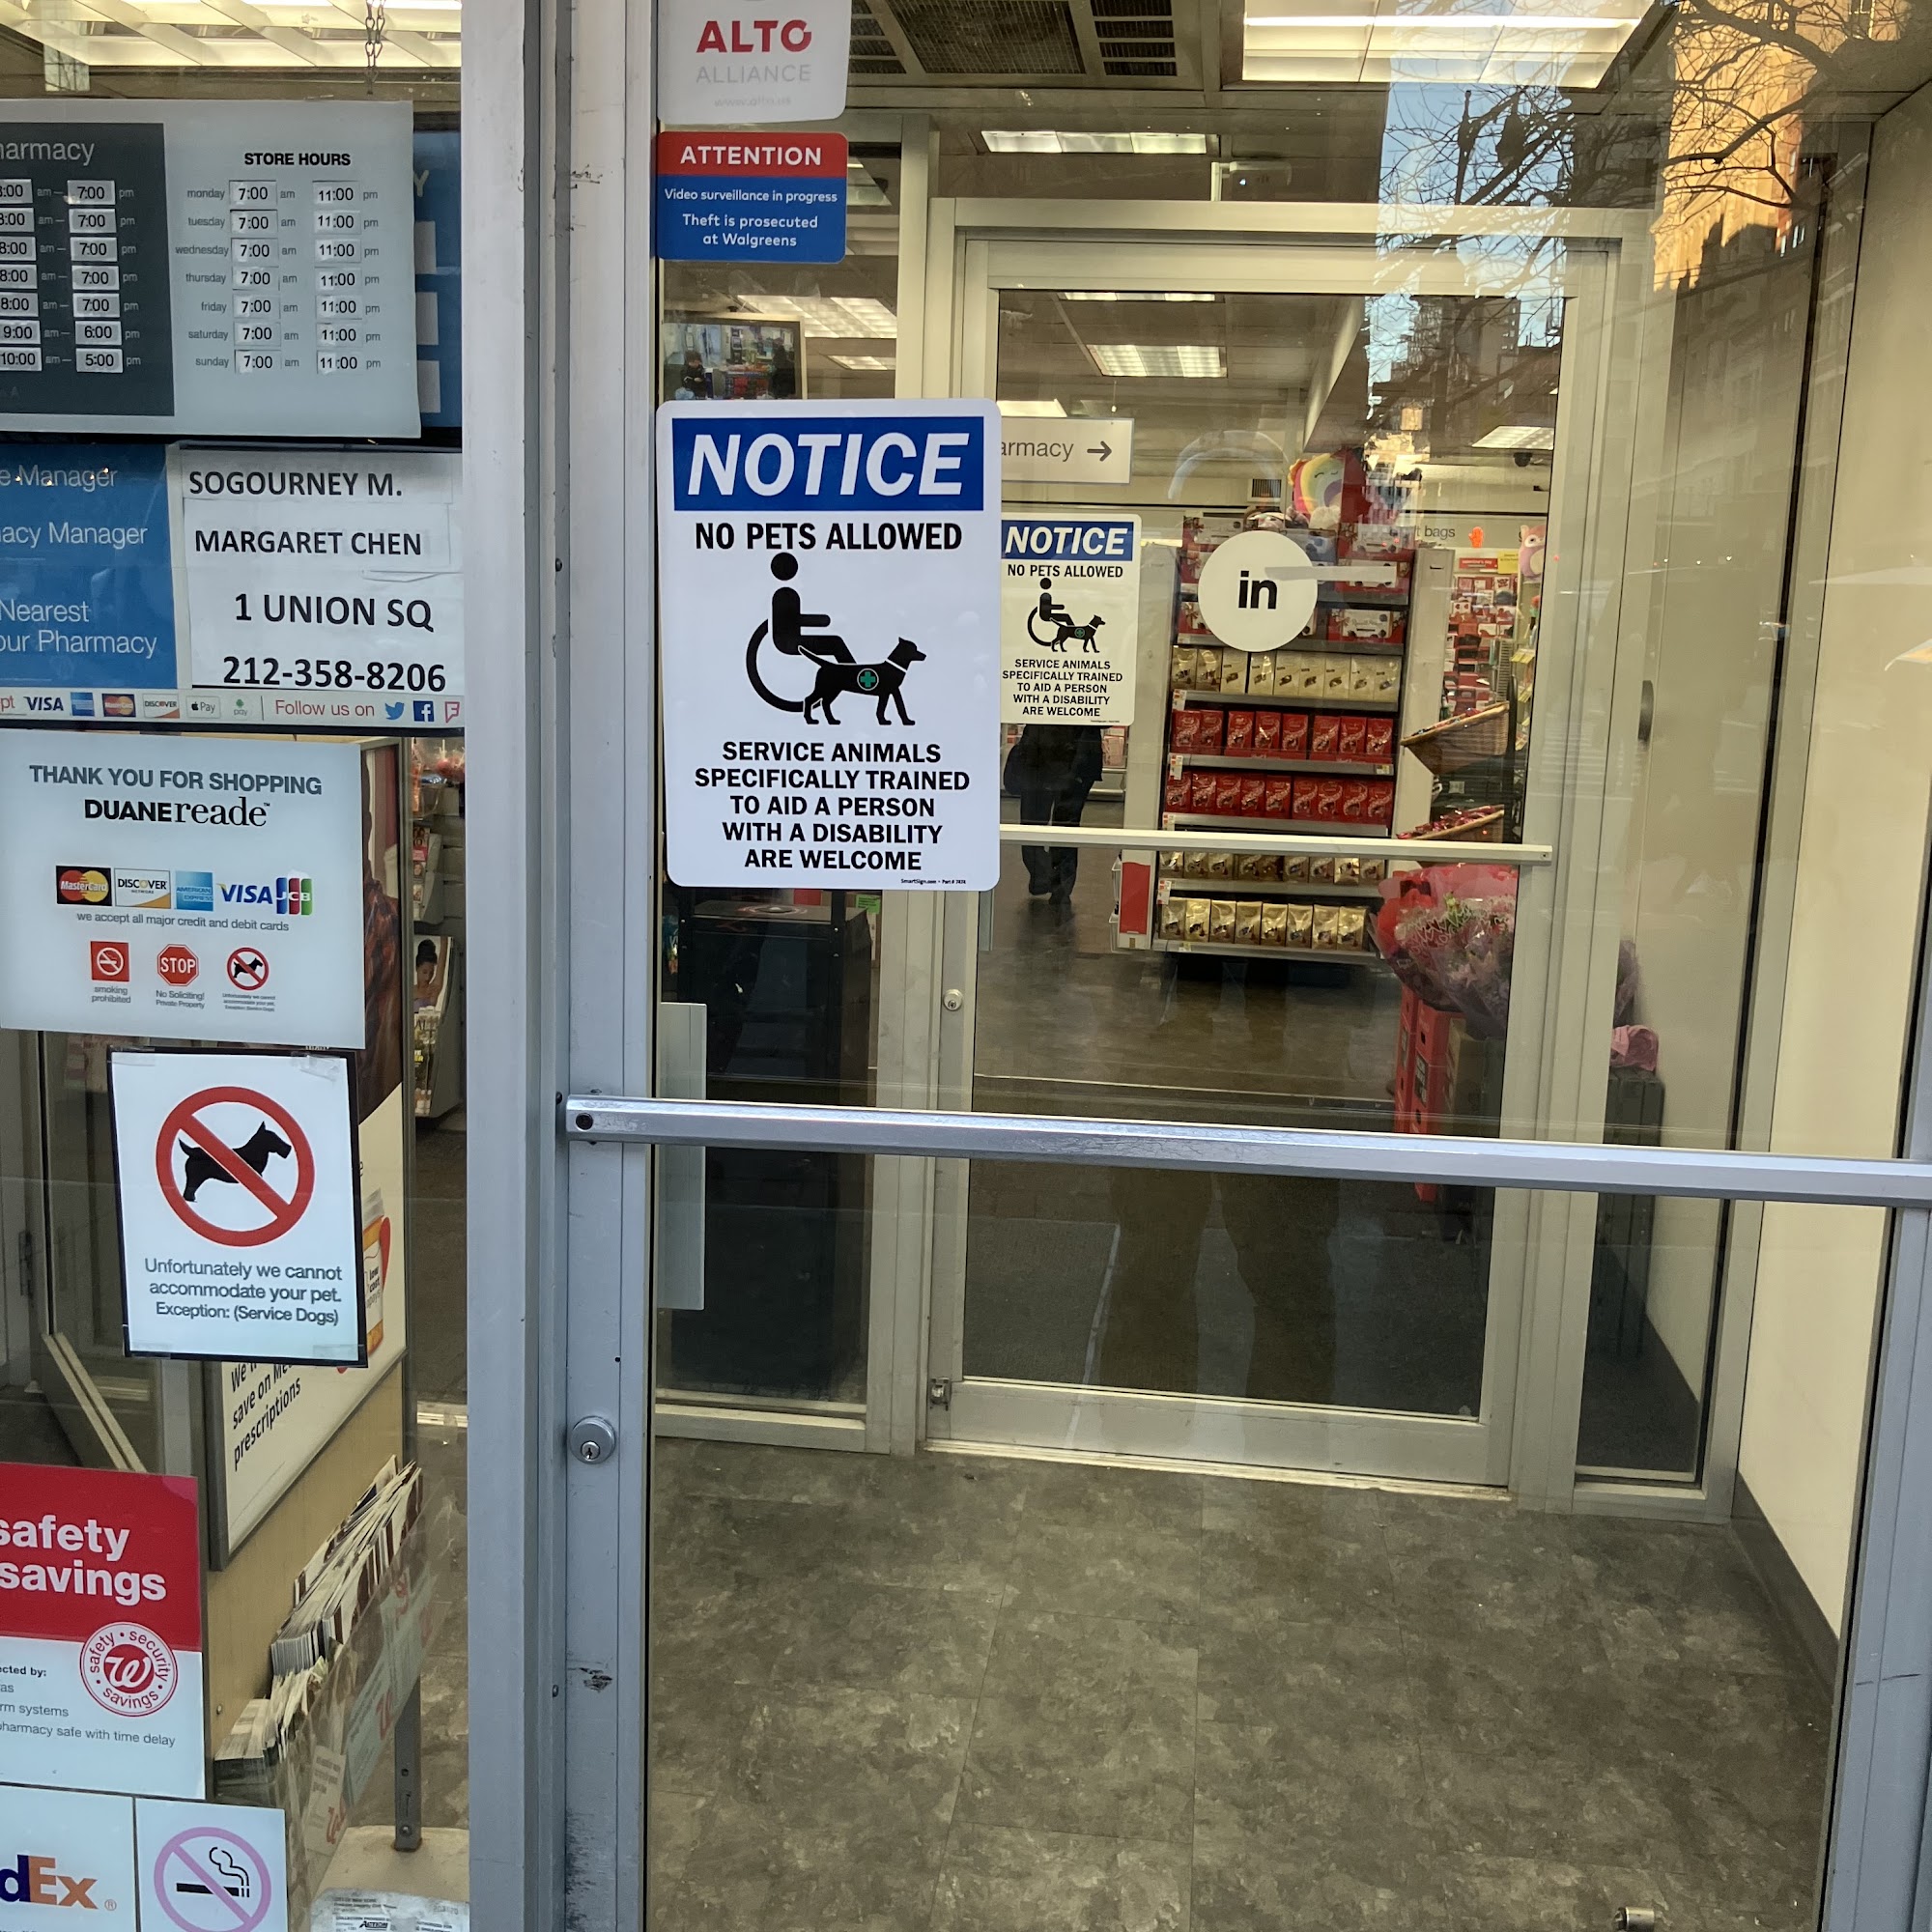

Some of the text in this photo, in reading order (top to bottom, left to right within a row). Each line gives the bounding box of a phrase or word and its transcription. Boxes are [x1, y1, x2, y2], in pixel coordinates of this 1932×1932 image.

[696, 20, 811, 52] ALTO
[696, 62, 810, 85] ALLIANCE
[245, 153, 351, 165] STORE HOURS
[681, 146, 820, 165] ATTENTION
[76, 186, 104, 201] 7:00
[187, 187, 353, 201] monday 7:00 11:00
[665, 188, 838, 204] Video surveillance in progress
[78, 214, 105, 227] 7:00
[188, 215, 354, 229] tuesday 7:00 11:00
[683, 213, 817, 229] Theft is prosecuted
[0, 242, 106, 255] 8:00 7:00
[703, 233, 796, 248] at Walgreens
[175, 244, 354, 257] wednesday 7:00 11:00
[0, 270, 108, 284] 8:00 7:00
[185, 271, 355, 286] thursday 7:00 11:00
[1, 298, 109, 311] 8:00 7:00
[201, 300, 355, 313] friday 7:00 11:00
[4, 326, 112, 339] 9:00 6:00
[187, 327, 355, 342] saturday 7:00 11:00
[1, 353, 113, 366] 10:00 5:00
[196, 355, 357, 369] sunday 7:00 11:00
[688, 433, 969, 496] NOTICE
[19, 465, 118, 492] Manager
[190, 471, 403, 497] SOGOURNEY M.
[49, 522, 148, 550] Manager
[196, 530, 420, 554] MARGARET CHEN
[696, 523, 961, 550] NO PETS ALLOWED
[1005, 526, 1127, 554] NOTICE
[1425, 526, 1455, 540] bags
[1009, 564, 1122, 579] NO PETS ALLOWED
[1238, 571, 1277, 609] in
[0, 598, 89, 622] Nearest
[236, 594, 434, 632] 1 UNION SQ
[39, 630, 156, 659] Pharmacy
[1015, 659, 1110, 669] SERVICE ANIMALS
[221, 657, 445, 692] 212-358-8206
[1003, 670, 1122, 681] SPECIFICALLY TRAINED
[1065, 684, 1106, 693] PERSON
[0, 696, 15, 714] pt
[24, 696, 64, 711] VISA
[144, 699, 178, 708] DISCOVER
[200, 702, 215, 714] Pay
[275, 700, 375, 717] Follow us on
[1013, 695, 1039, 703] WITH
[1053, 696, 1110, 704] DISABILITY
[1023, 706, 1100, 716] ARE WELCOME
[723, 742, 940, 762] SERVICE ANIMALS
[29, 765, 322, 794] THANK YOU FOR SHOPPING
[696, 768, 969, 789] SPECIFICALLY TRAINED
[730, 796, 934, 816] TO AID A PERSON
[723, 822, 943, 843] WITH A DISABILITY
[745, 849, 921, 869] ARE WELCOME
[118, 879, 273, 904] DISCOVER VISA
[95, 914, 129, 923] accept
[132, 914, 143, 923] all
[147, 917, 175, 926] major
[178, 918, 206, 926] credit
[209, 919, 228, 927] and
[231, 920, 257, 929] debit
[260, 922, 289, 931] cards
[159, 956, 195, 974] STOP
[92, 995, 130, 1004] prohibited
[93, 986, 128, 997] smoking
[179, 999, 205, 1009] Property
[145, 1259, 342, 1280] Unfortunately we cannot
[150, 1283, 341, 1304] accommodate your pet.
[156, 1302, 338, 1326] Exception: (Service Dogs)
[233, 1391, 255, 1430] save
[258, 1374, 270, 1400] on
[235, 1378, 300, 1472] prescriptions
[0, 1559, 166, 1606] savings
[89, 1633, 115, 1673] safety
[129, 1632, 171, 1682] security
[31, 1667, 45, 1678] by:
[102, 1688, 158, 1708] savings
[19, 1705, 69, 1717] systems
[0, 1722, 175, 1747] harmacy safe with time delay
[0, 1855, 99, 1910] dEx
